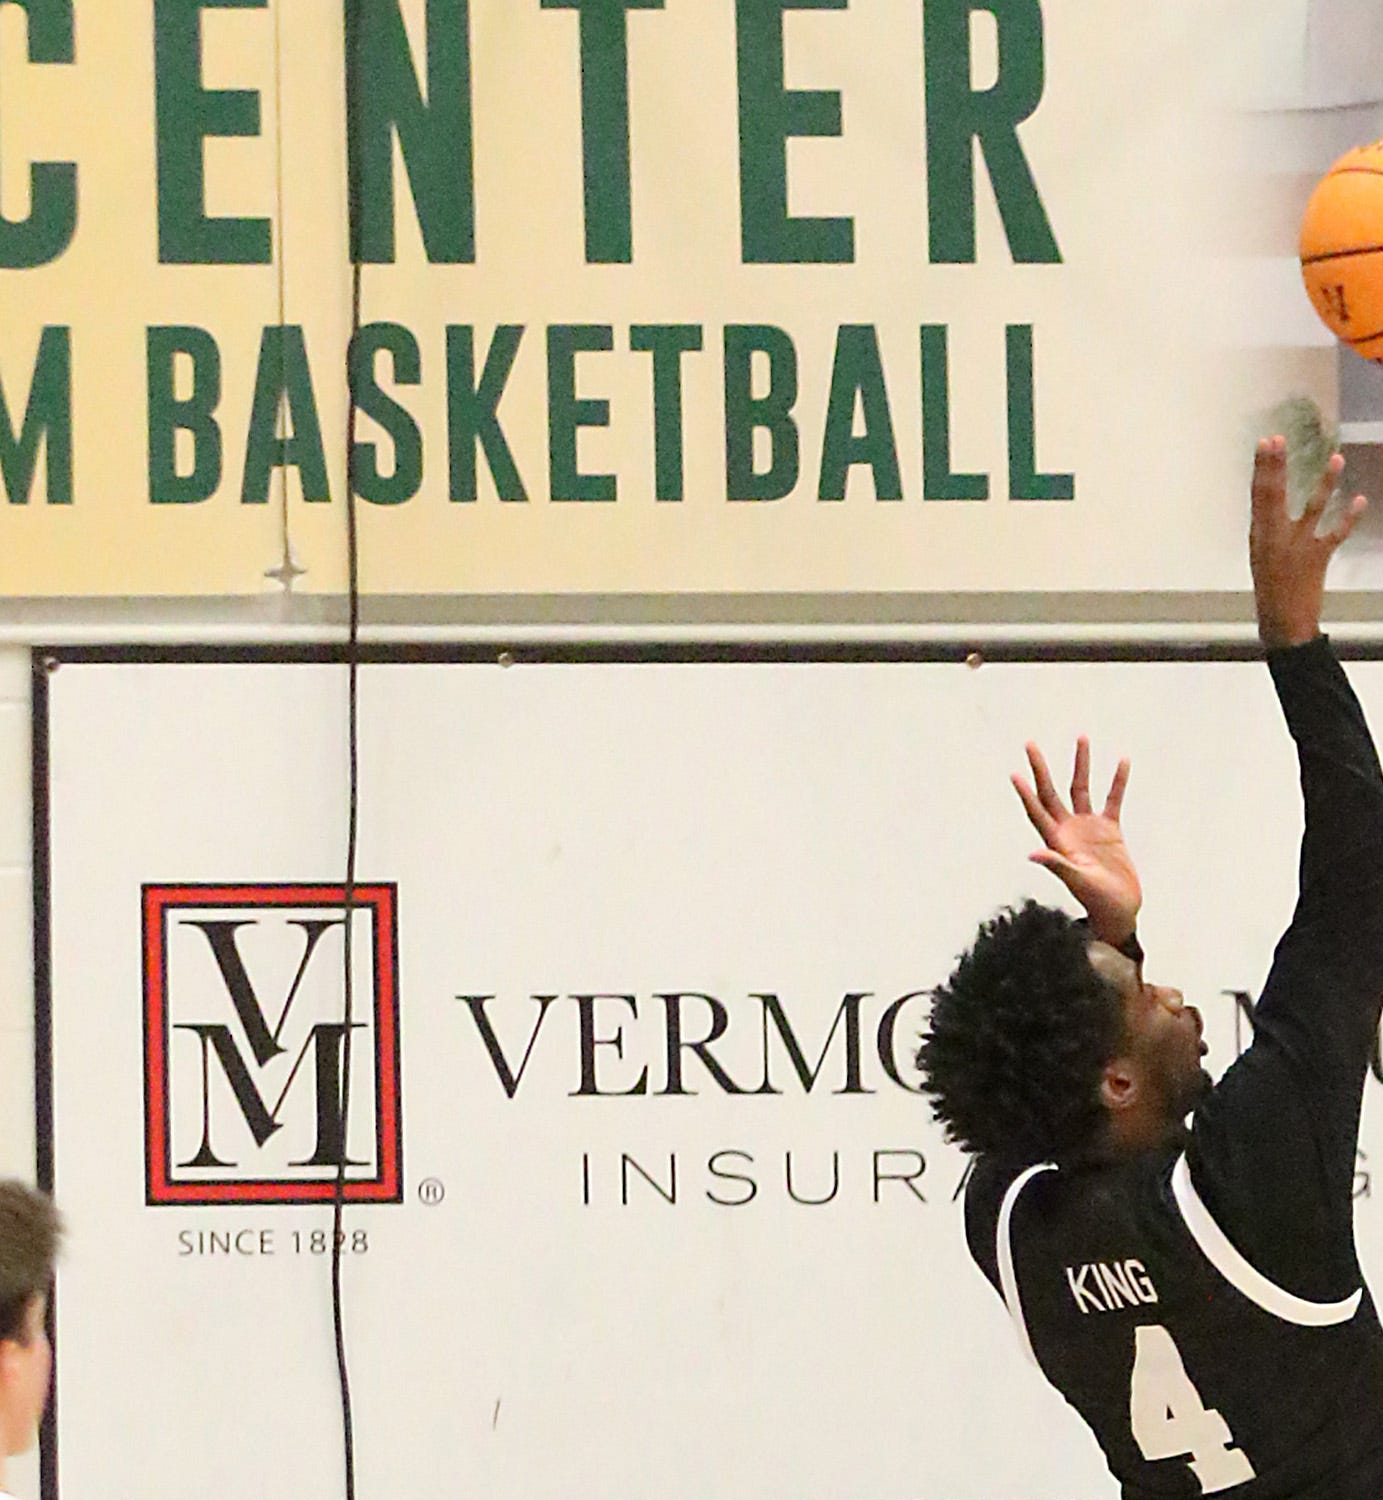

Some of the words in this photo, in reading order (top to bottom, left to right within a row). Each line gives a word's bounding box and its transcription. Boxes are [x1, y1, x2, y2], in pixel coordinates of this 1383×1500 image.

[0, 0, 1063, 268] CENTER
[145, 322, 1075, 504] BASKETBALL
[455, 991, 936, 1099] VERMO
[581, 1150, 978, 1205] INSUR
[177, 1229, 275, 1256] SINCE
[1066, 1258, 1159, 1314] KING
[1130, 1324, 1257, 1495] 4
